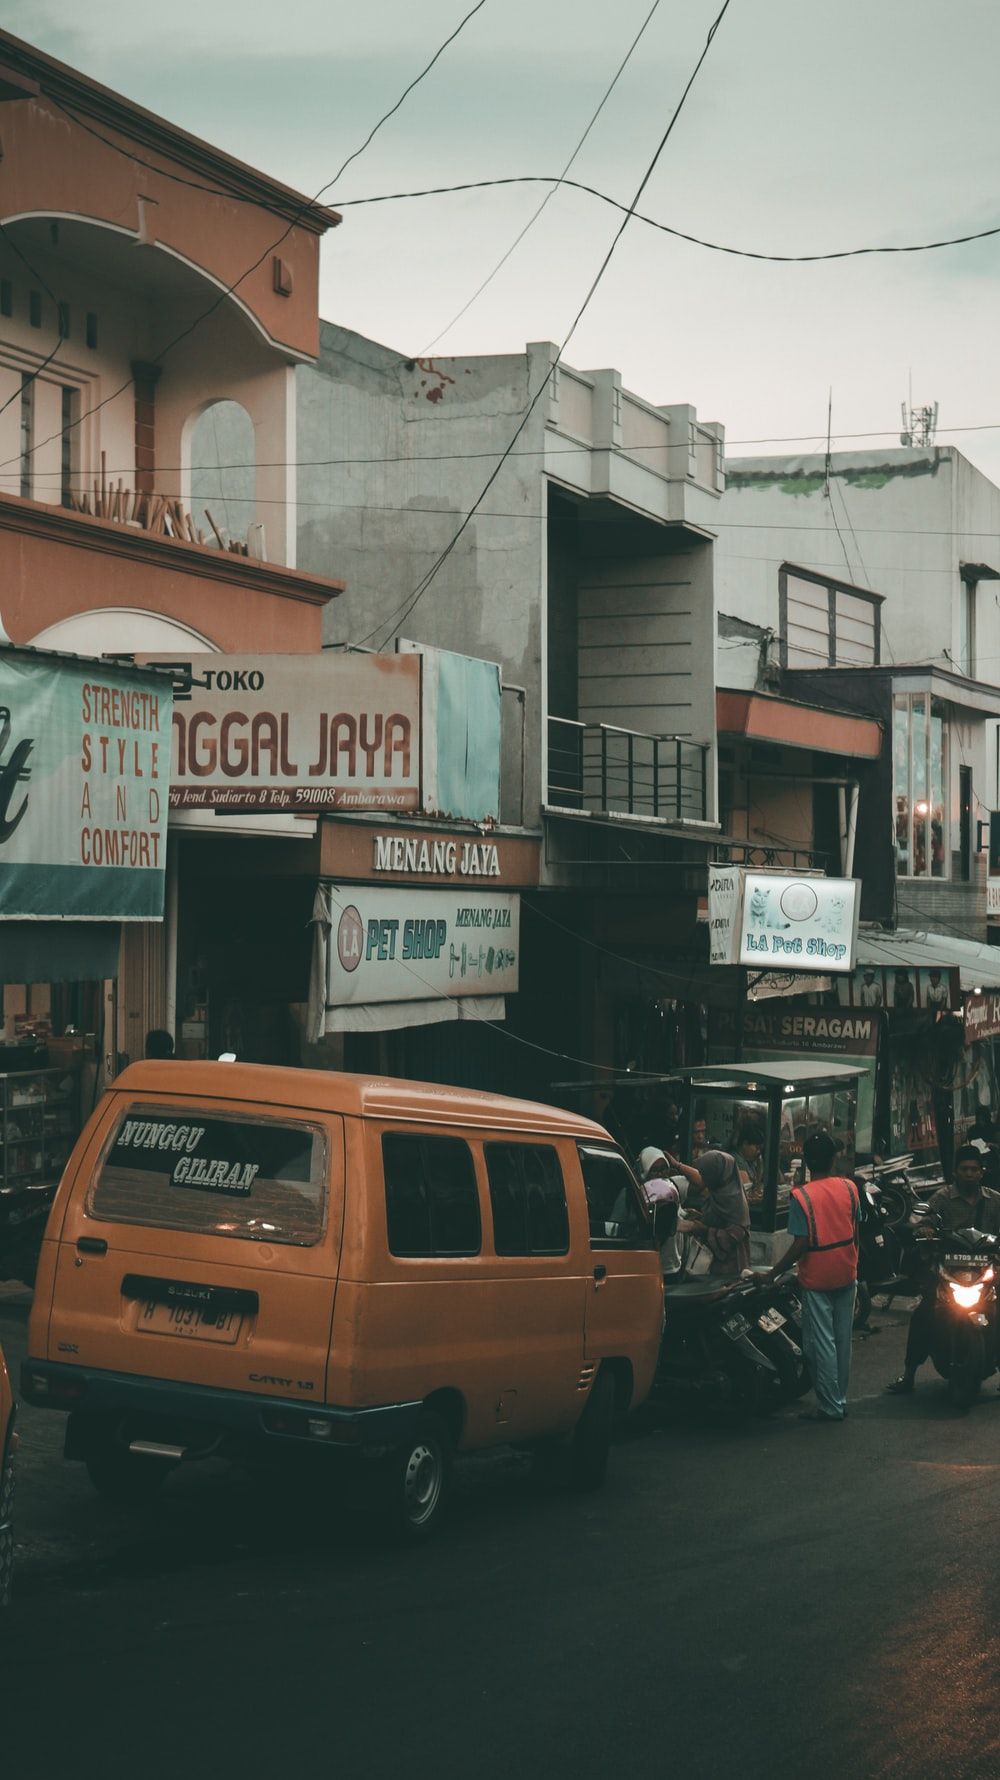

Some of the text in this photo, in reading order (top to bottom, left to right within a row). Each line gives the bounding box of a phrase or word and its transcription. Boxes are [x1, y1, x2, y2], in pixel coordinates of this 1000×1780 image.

[203, 670, 264, 691] TOKO
[82, 683, 159, 731] STRENGTH
[82, 734, 158, 778] STYLE
[309, 712, 411, 777] JAYA
[81, 782, 159, 823] AND
[259, 789, 266, 803] 8
[295, 788, 335, 804] 591008
[337, 792, 405, 805] Ambarawa
[81, 827, 160, 867] COMFORT
[374, 836, 500, 876] MENANG JAYA
[456, 908, 511, 929] MENANG JAYA
[343, 919, 446, 960] LA PET SHOP
[747, 934, 846, 960] LA Pet Shop
[781, 1016, 871, 1040] SERAGAM
[117, 1120, 205, 1152] NUNGGU
[173, 1157, 259, 1190] GILIRAN
[168, 1287, 211, 1300] SUZUKI
[249, 1374, 293, 1387] CARRY
